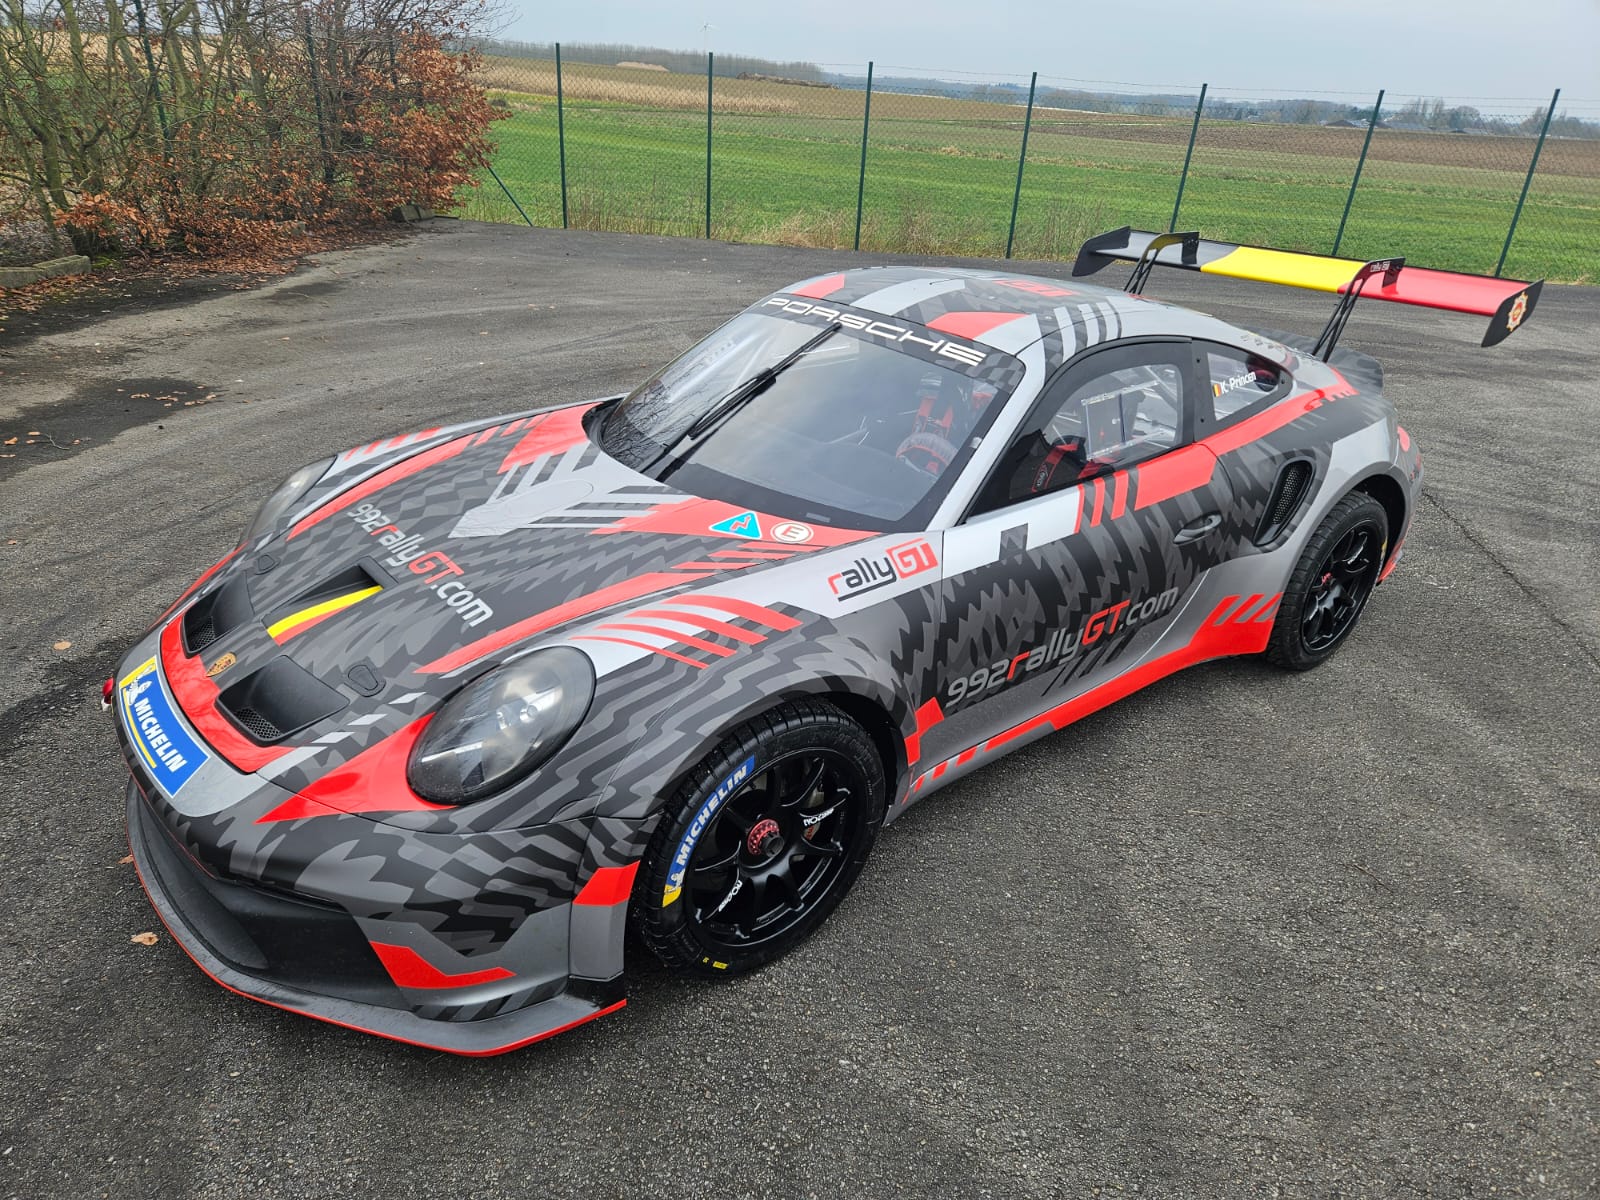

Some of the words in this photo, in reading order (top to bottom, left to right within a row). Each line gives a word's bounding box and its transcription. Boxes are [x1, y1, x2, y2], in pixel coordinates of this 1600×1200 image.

[761, 298, 987, 367] PORSCHE
[1229, 371, 1257, 390] Princen
[347, 503, 494, 628] 992rallyGT.com
[945, 587, 1179, 708] 992rallyGT.com
[134, 697, 188, 773] MICHELIN
[676, 764, 747, 866] MICHELIN
